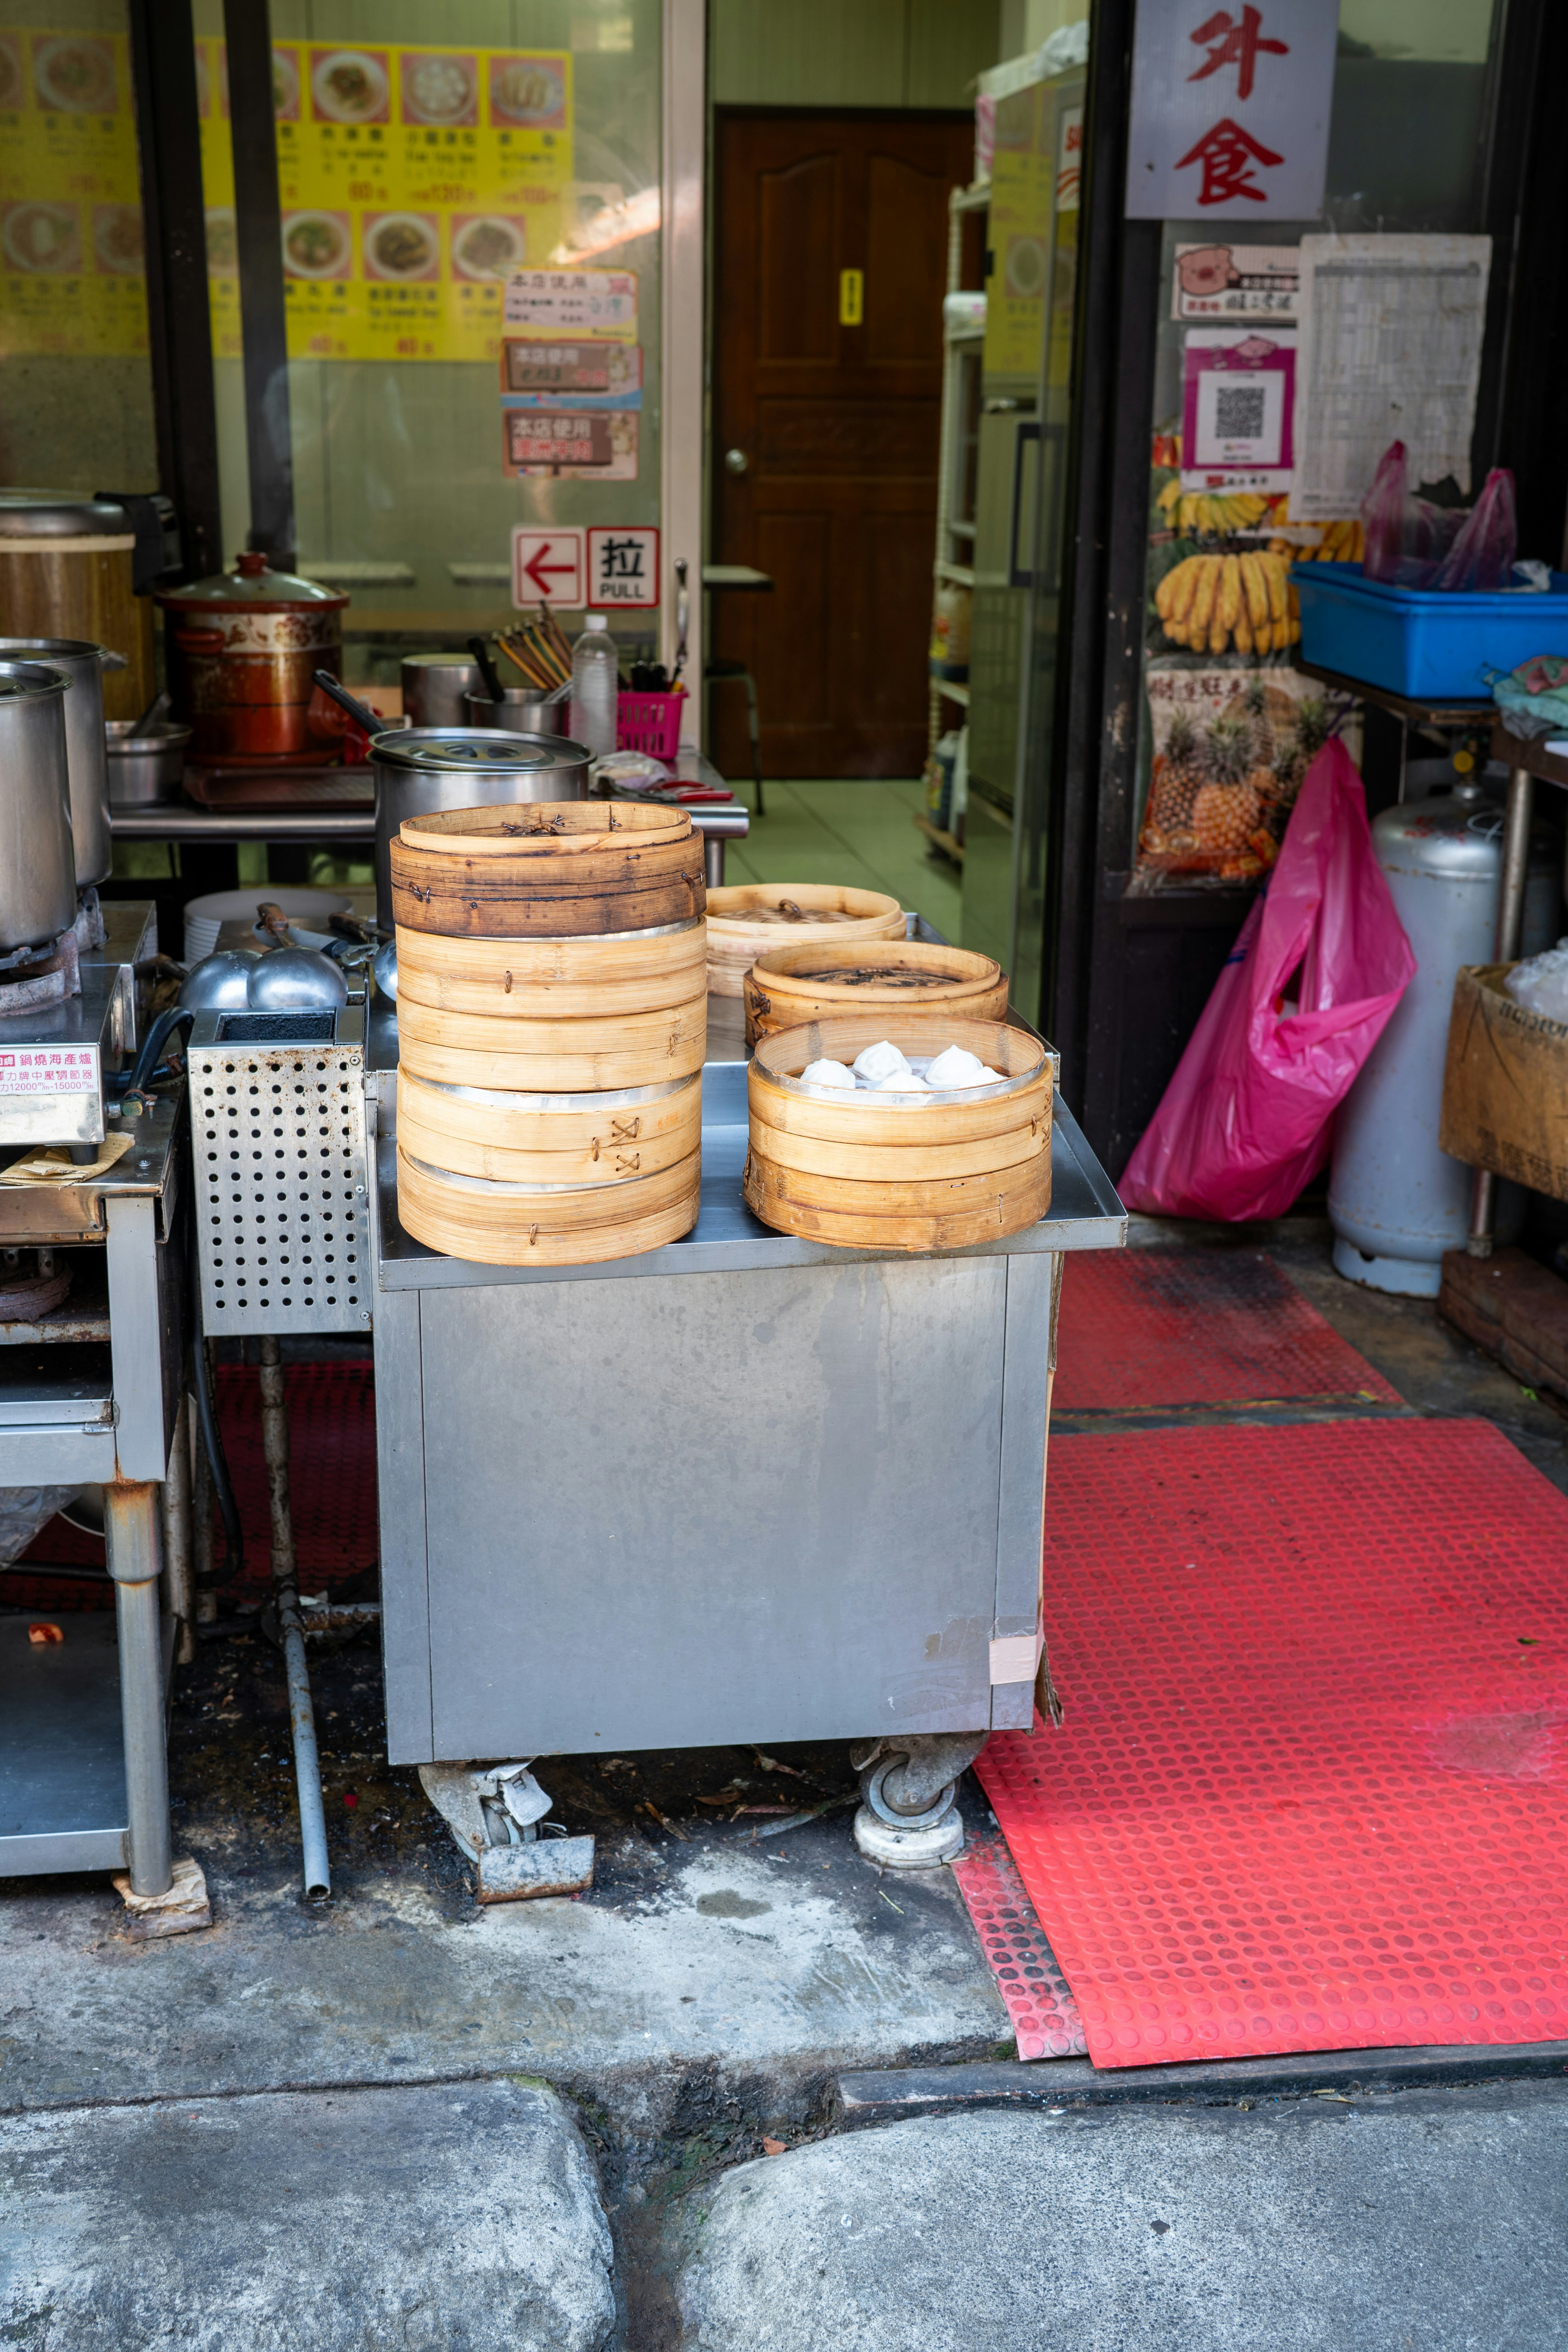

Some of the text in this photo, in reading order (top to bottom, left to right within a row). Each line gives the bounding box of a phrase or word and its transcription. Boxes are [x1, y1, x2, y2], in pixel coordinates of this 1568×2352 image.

[1175, 3, 1289, 206] 外食
[516, 347, 579, 365] 本店使用
[513, 418, 591, 439] 本店使用
[513, 438, 593, 461] 澳洲牛肉
[602, 537, 644, 578] 拉
[600, 583, 644, 599] PULL
[19, 1053, 92, 1066] 鍋燒海產爐
